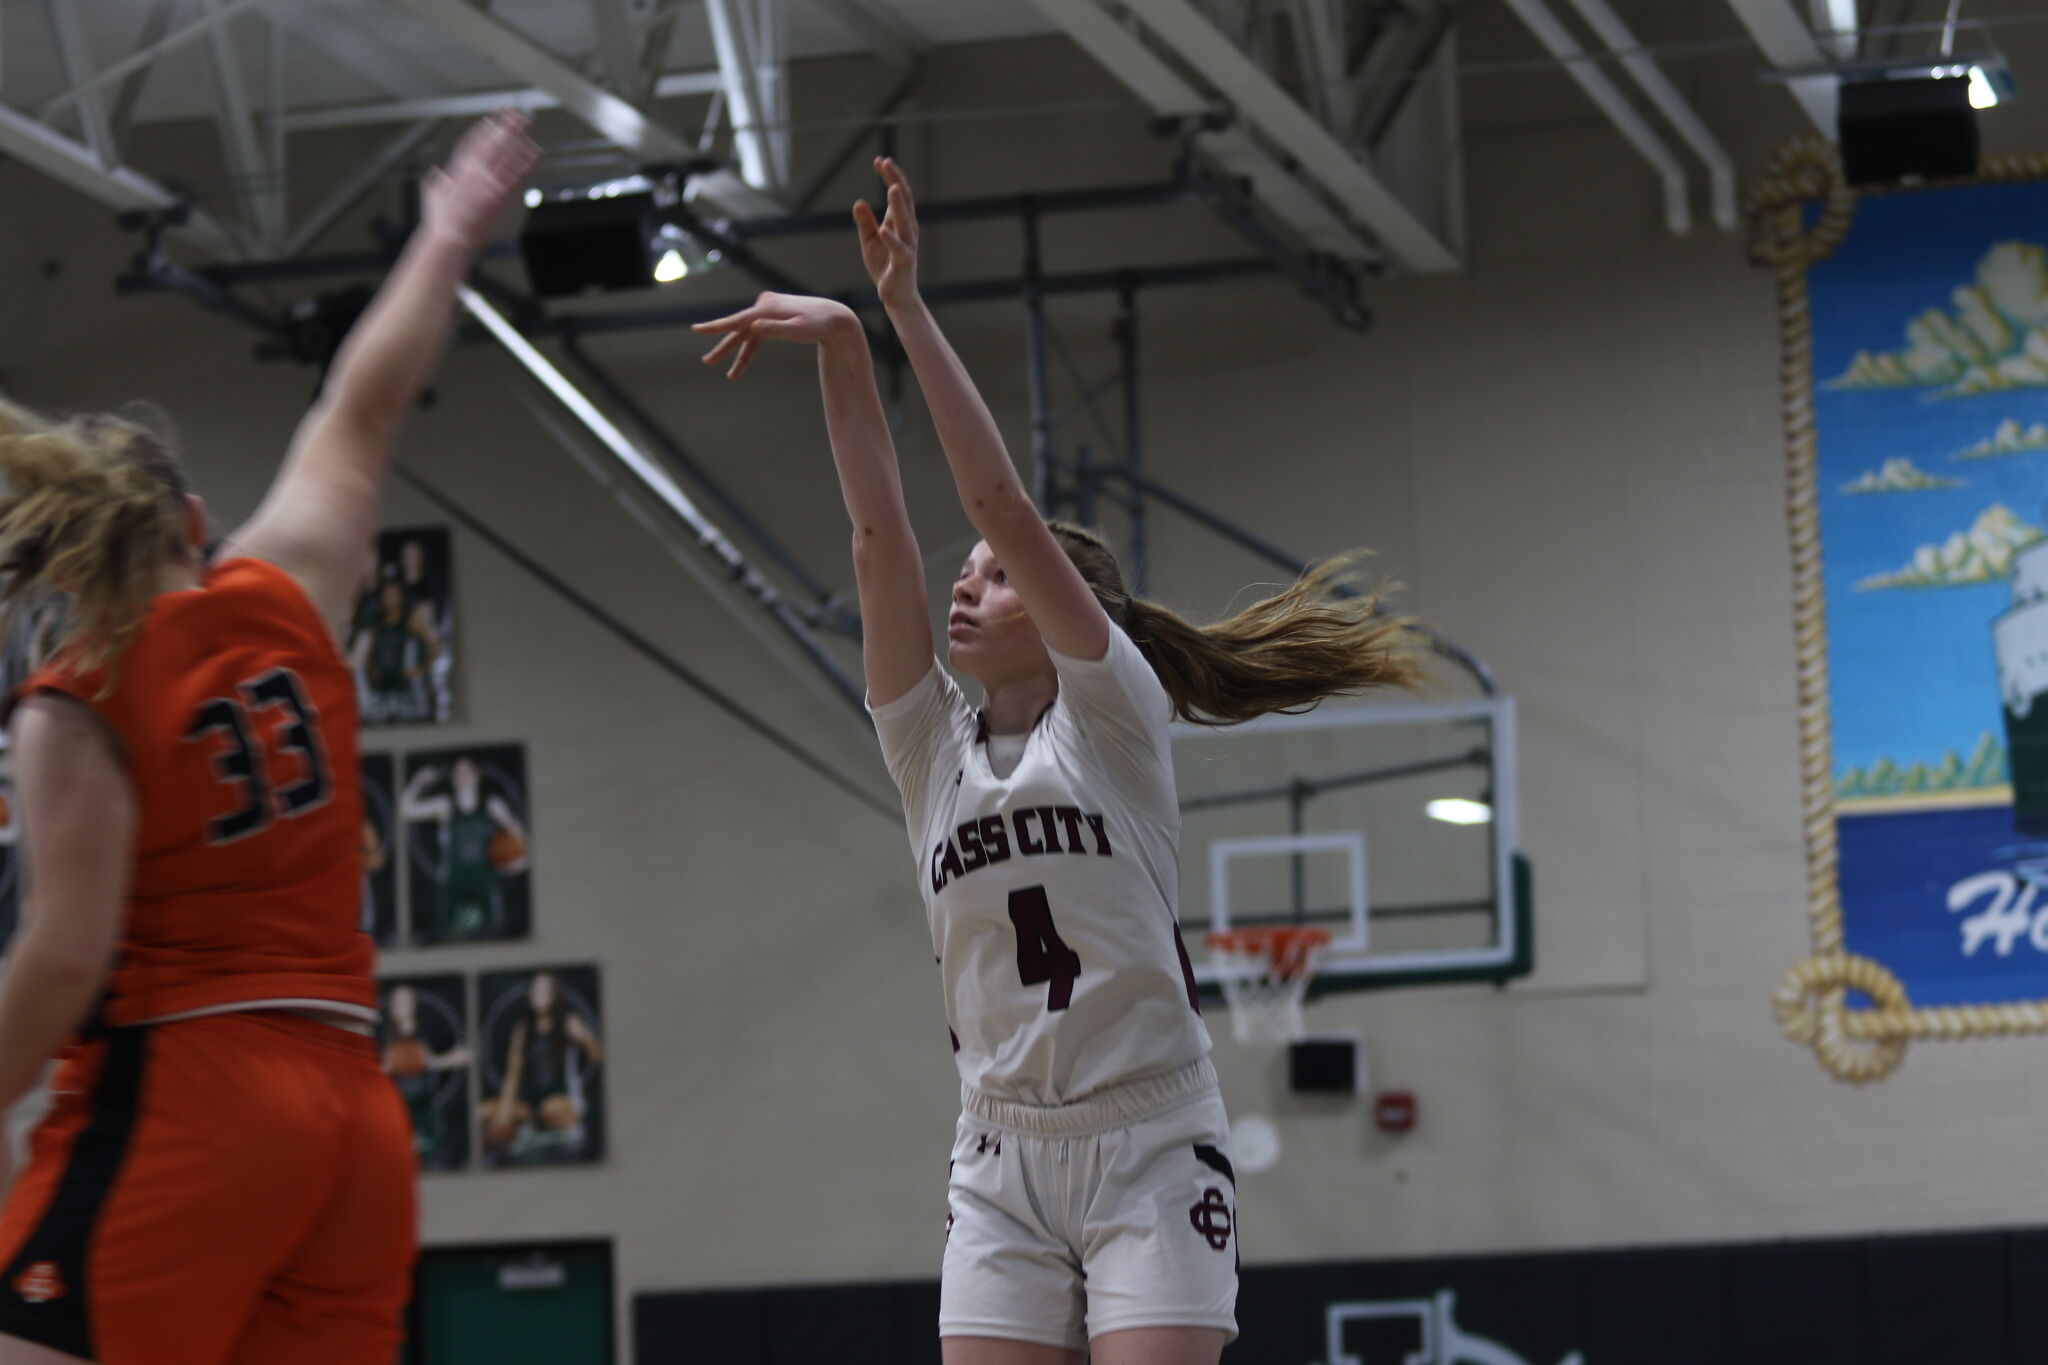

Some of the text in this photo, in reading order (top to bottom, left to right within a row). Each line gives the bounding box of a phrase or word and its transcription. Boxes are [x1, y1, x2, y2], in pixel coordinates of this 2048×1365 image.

[180, 666, 335, 846] 33
[931, 805, 1112, 895] CASS CITY
[1008, 884, 1081, 1012] 4
